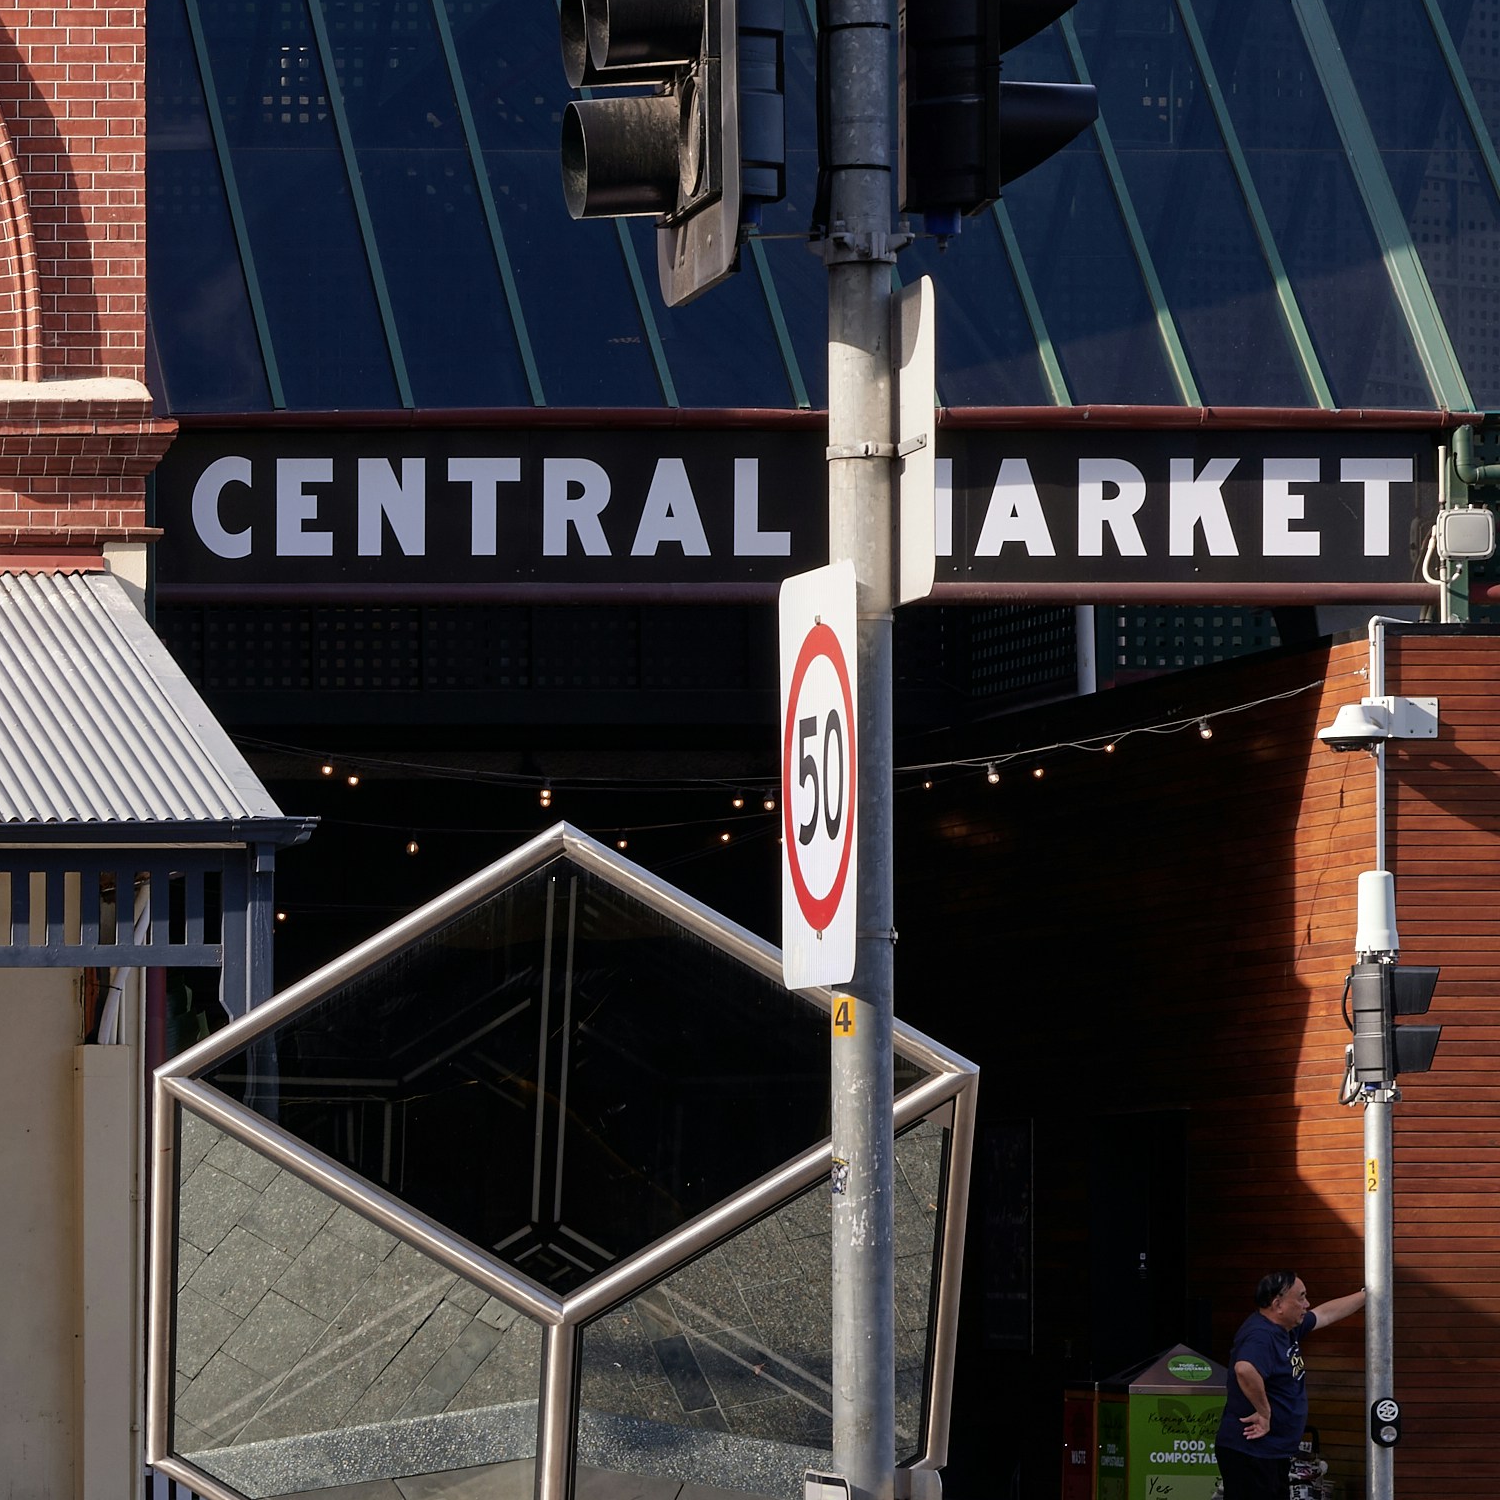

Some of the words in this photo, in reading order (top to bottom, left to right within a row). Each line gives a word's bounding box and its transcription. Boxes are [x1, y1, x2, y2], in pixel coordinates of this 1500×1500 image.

[192, 456, 791, 558] CENTRAL
[799, 708, 844, 846] 50
[835, 1002, 852, 1031] 4
[1174, 1440, 1205, 1451] FOOD
[1149, 1477, 1173, 1495] Yes
